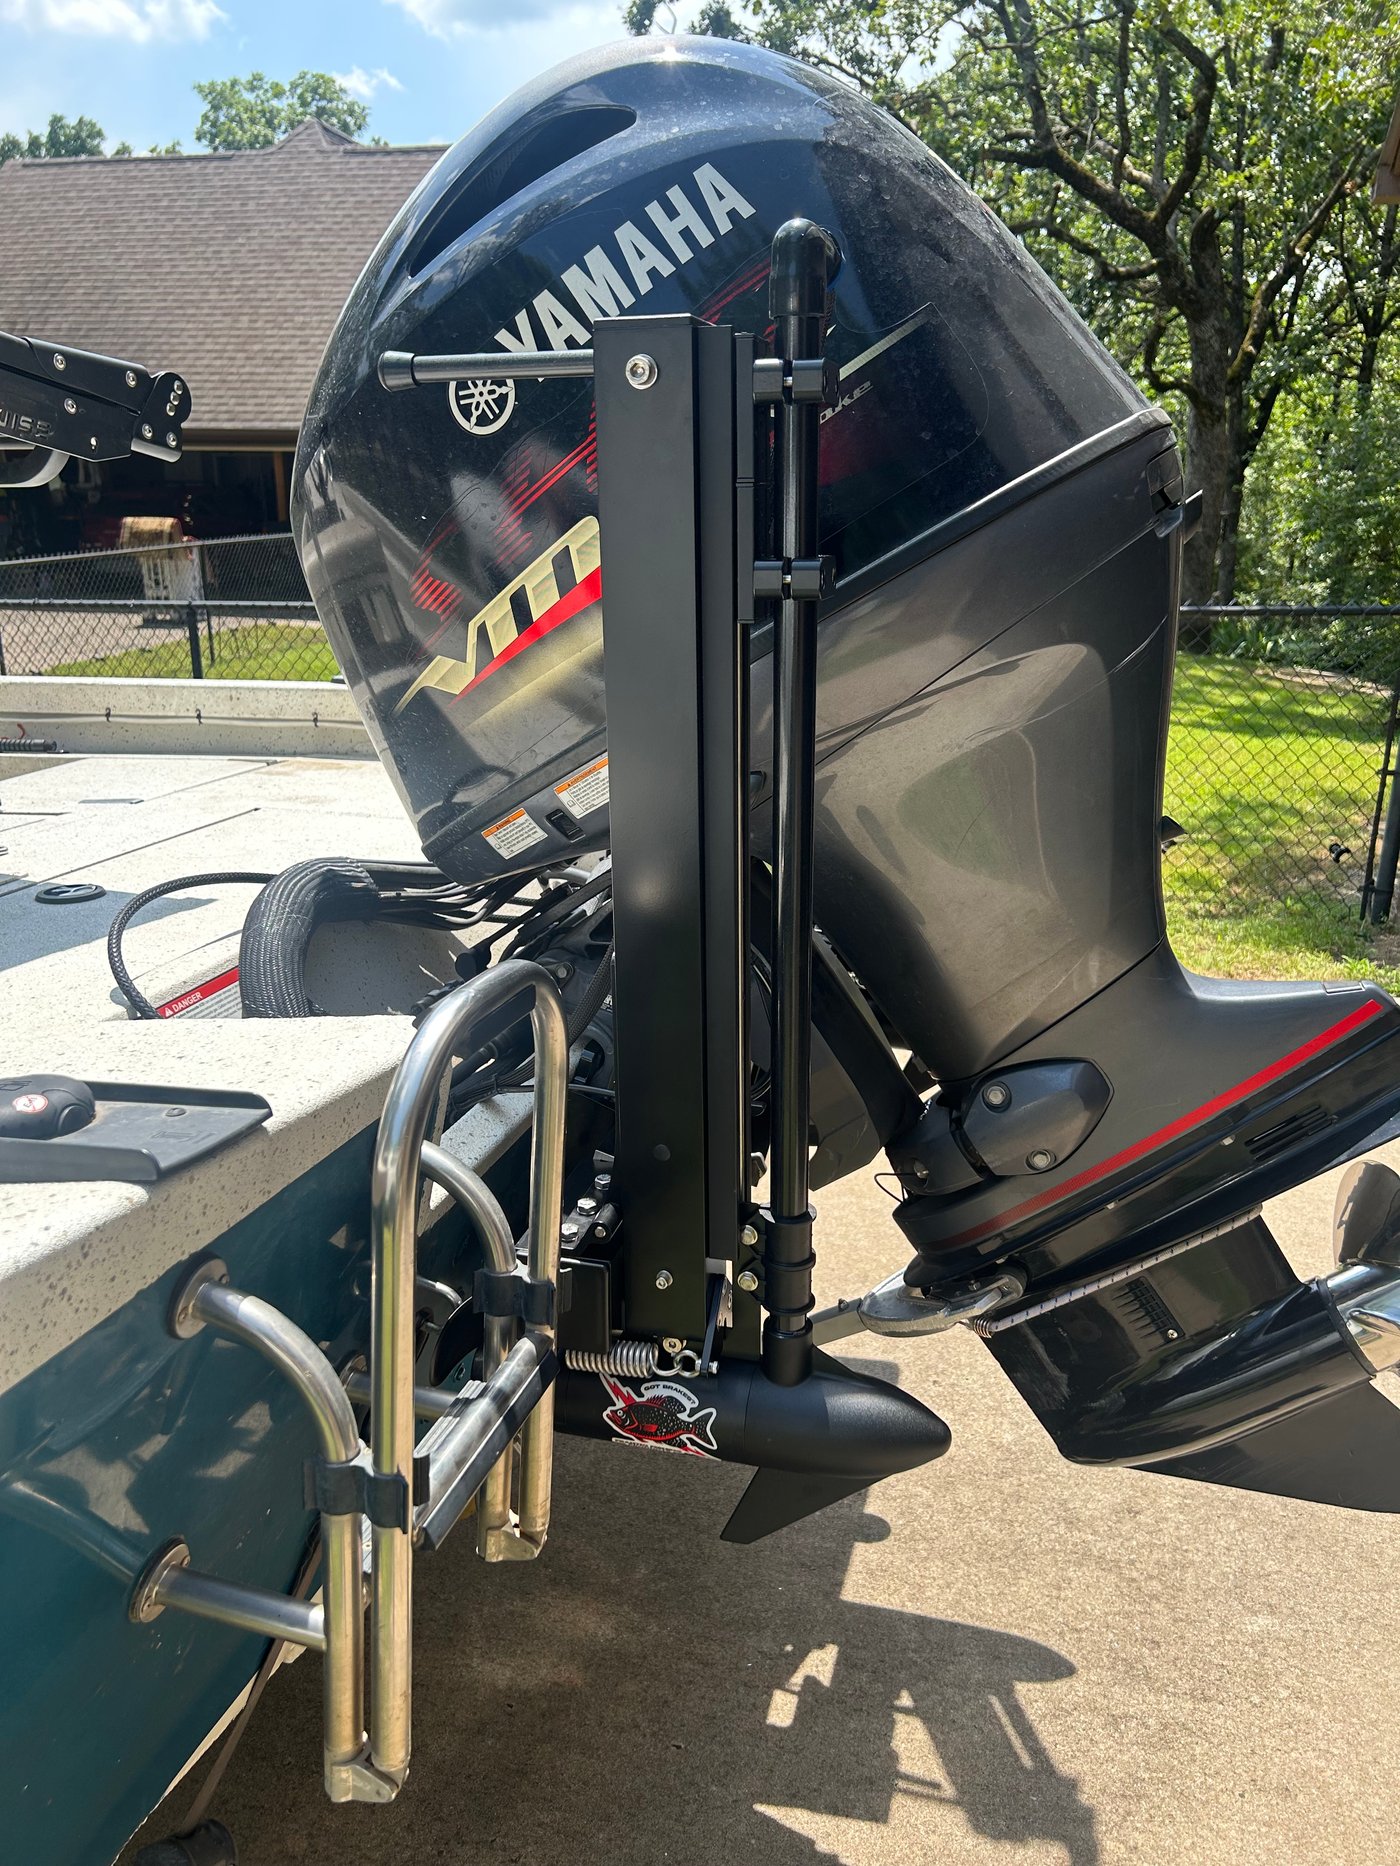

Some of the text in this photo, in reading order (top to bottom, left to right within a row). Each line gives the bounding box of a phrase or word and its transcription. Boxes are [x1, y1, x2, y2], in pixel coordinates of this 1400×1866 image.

[494, 162, 757, 382] YAMAHA
[172, 991, 203, 1011] DANGER
[643, 1383, 660, 1391] GOT
